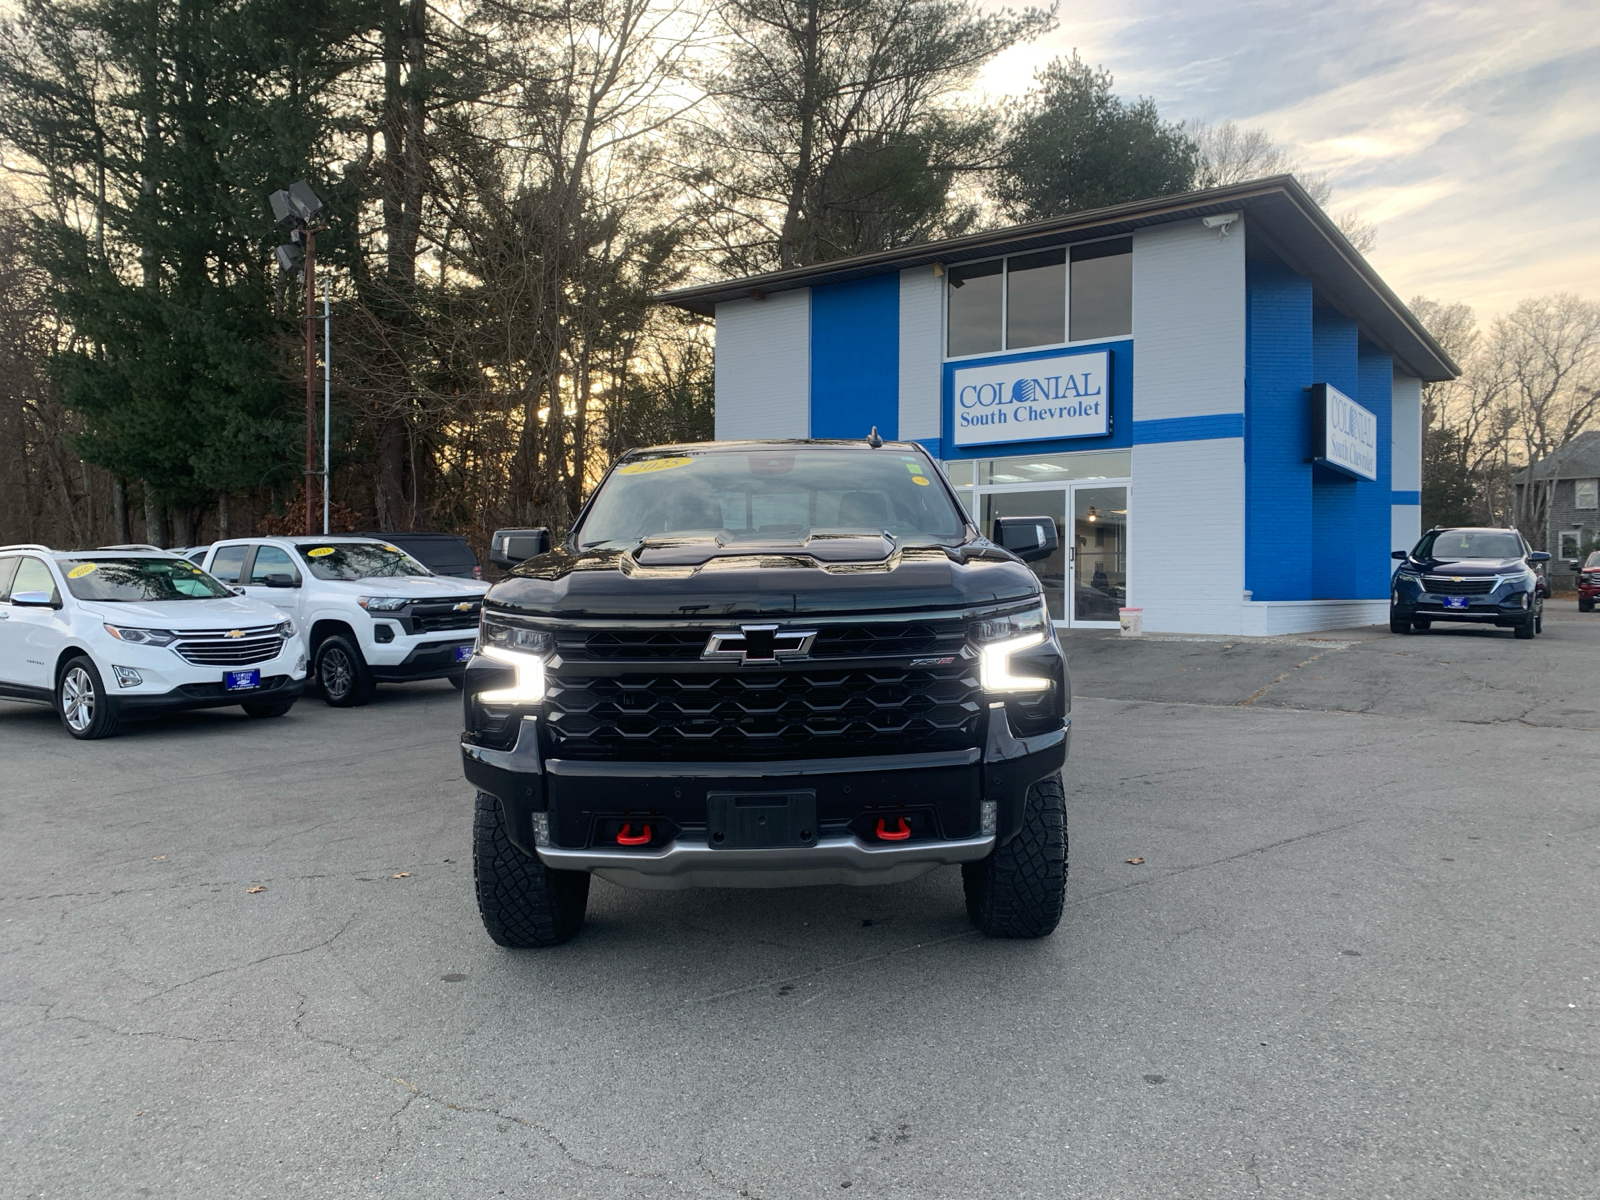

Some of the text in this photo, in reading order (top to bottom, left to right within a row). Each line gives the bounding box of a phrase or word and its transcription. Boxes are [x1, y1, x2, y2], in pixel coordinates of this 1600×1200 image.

[959, 372, 1101, 408] COLONIAL
[960, 400, 1101, 427] South Chevrolet
[1331, 395, 1374, 449] COLONIAL
[1331, 433, 1373, 473] South Chevrolet
